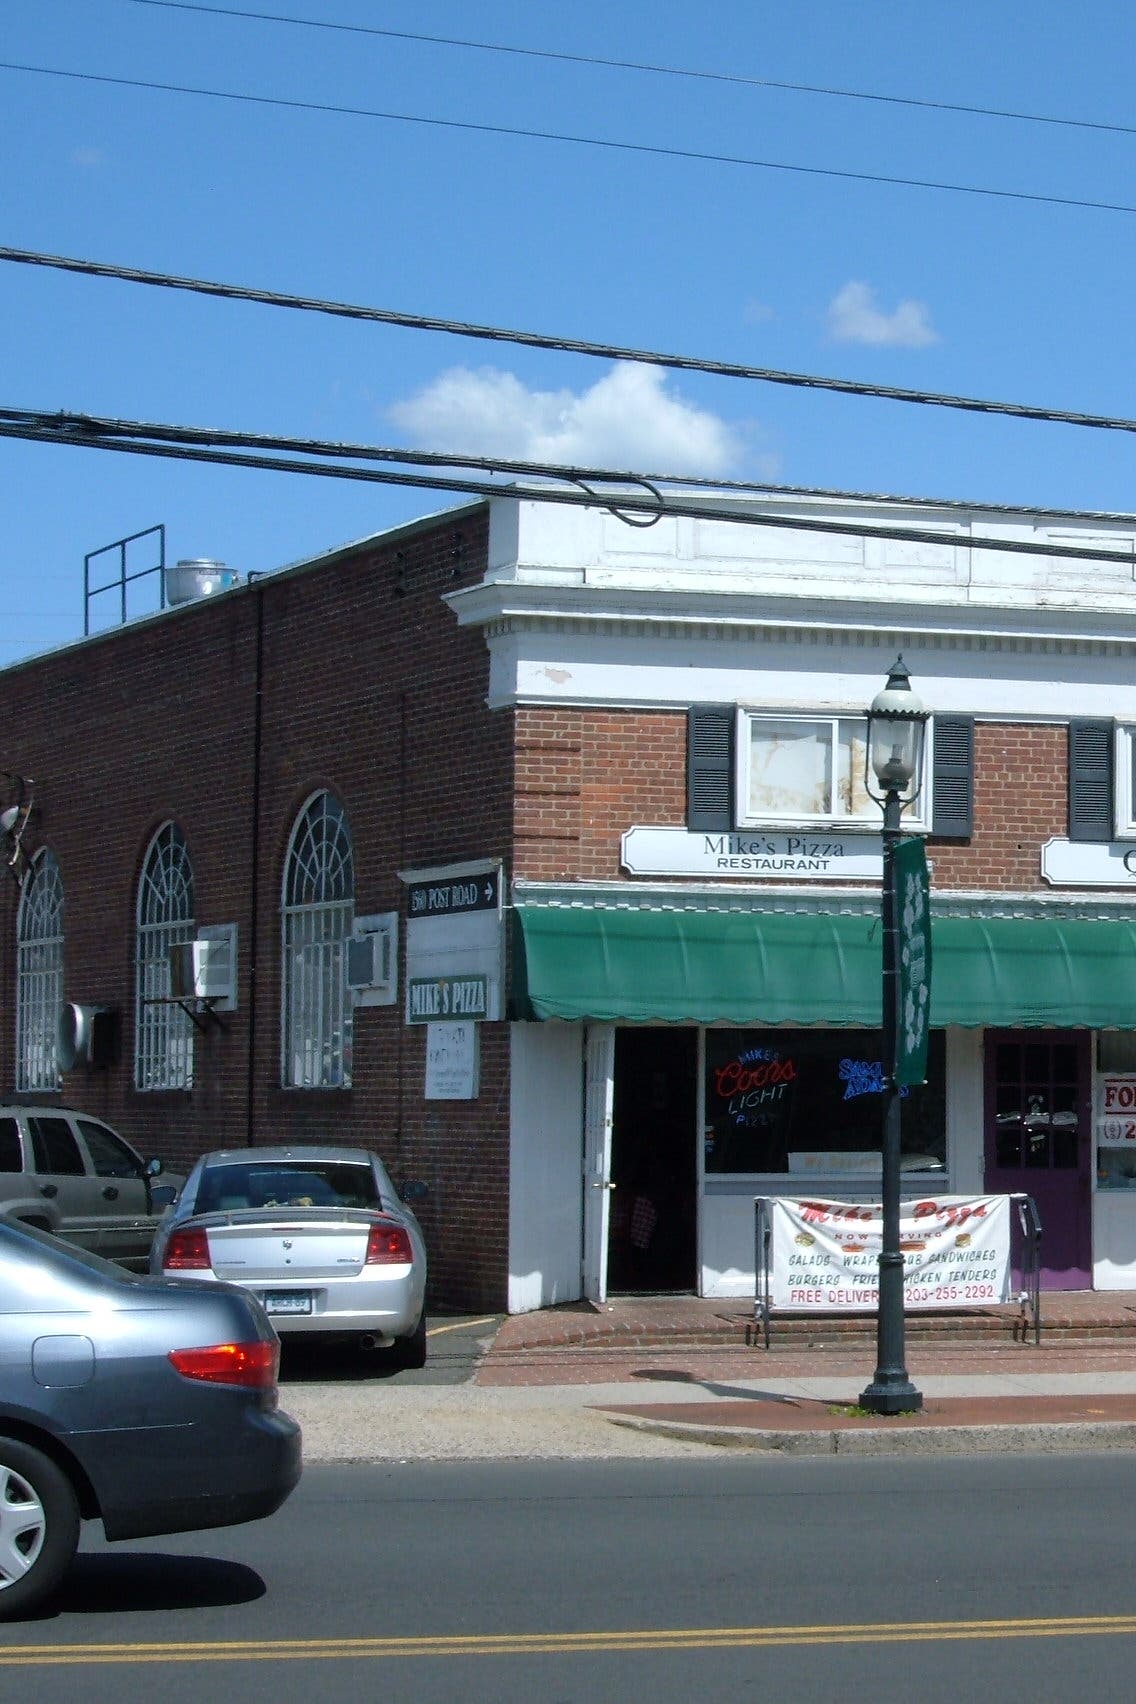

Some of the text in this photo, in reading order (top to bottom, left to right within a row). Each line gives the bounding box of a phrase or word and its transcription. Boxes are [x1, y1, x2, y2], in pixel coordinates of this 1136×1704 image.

[704, 835, 845, 859] Mike's Pizza
[717, 857, 831, 870] RESTAURANT
[428, 886, 451, 910] POST
[452, 882, 478, 907] ROAD
[452, 980, 486, 1014] PIZZA
[728, 1083, 789, 1115] LIGHT
[799, 1201, 988, 1228] Mike' Pizza
[834, 1232, 869, 1241] NOW
[788, 1254, 832, 1266] SALADS
[928, 1249, 996, 1264] SANDWICHES
[787, 1268, 997, 1286] BURGERS FRIE HICKEN TENDERS
[791, 1284, 994, 1303] FREE DELIVER 203-255-2292
